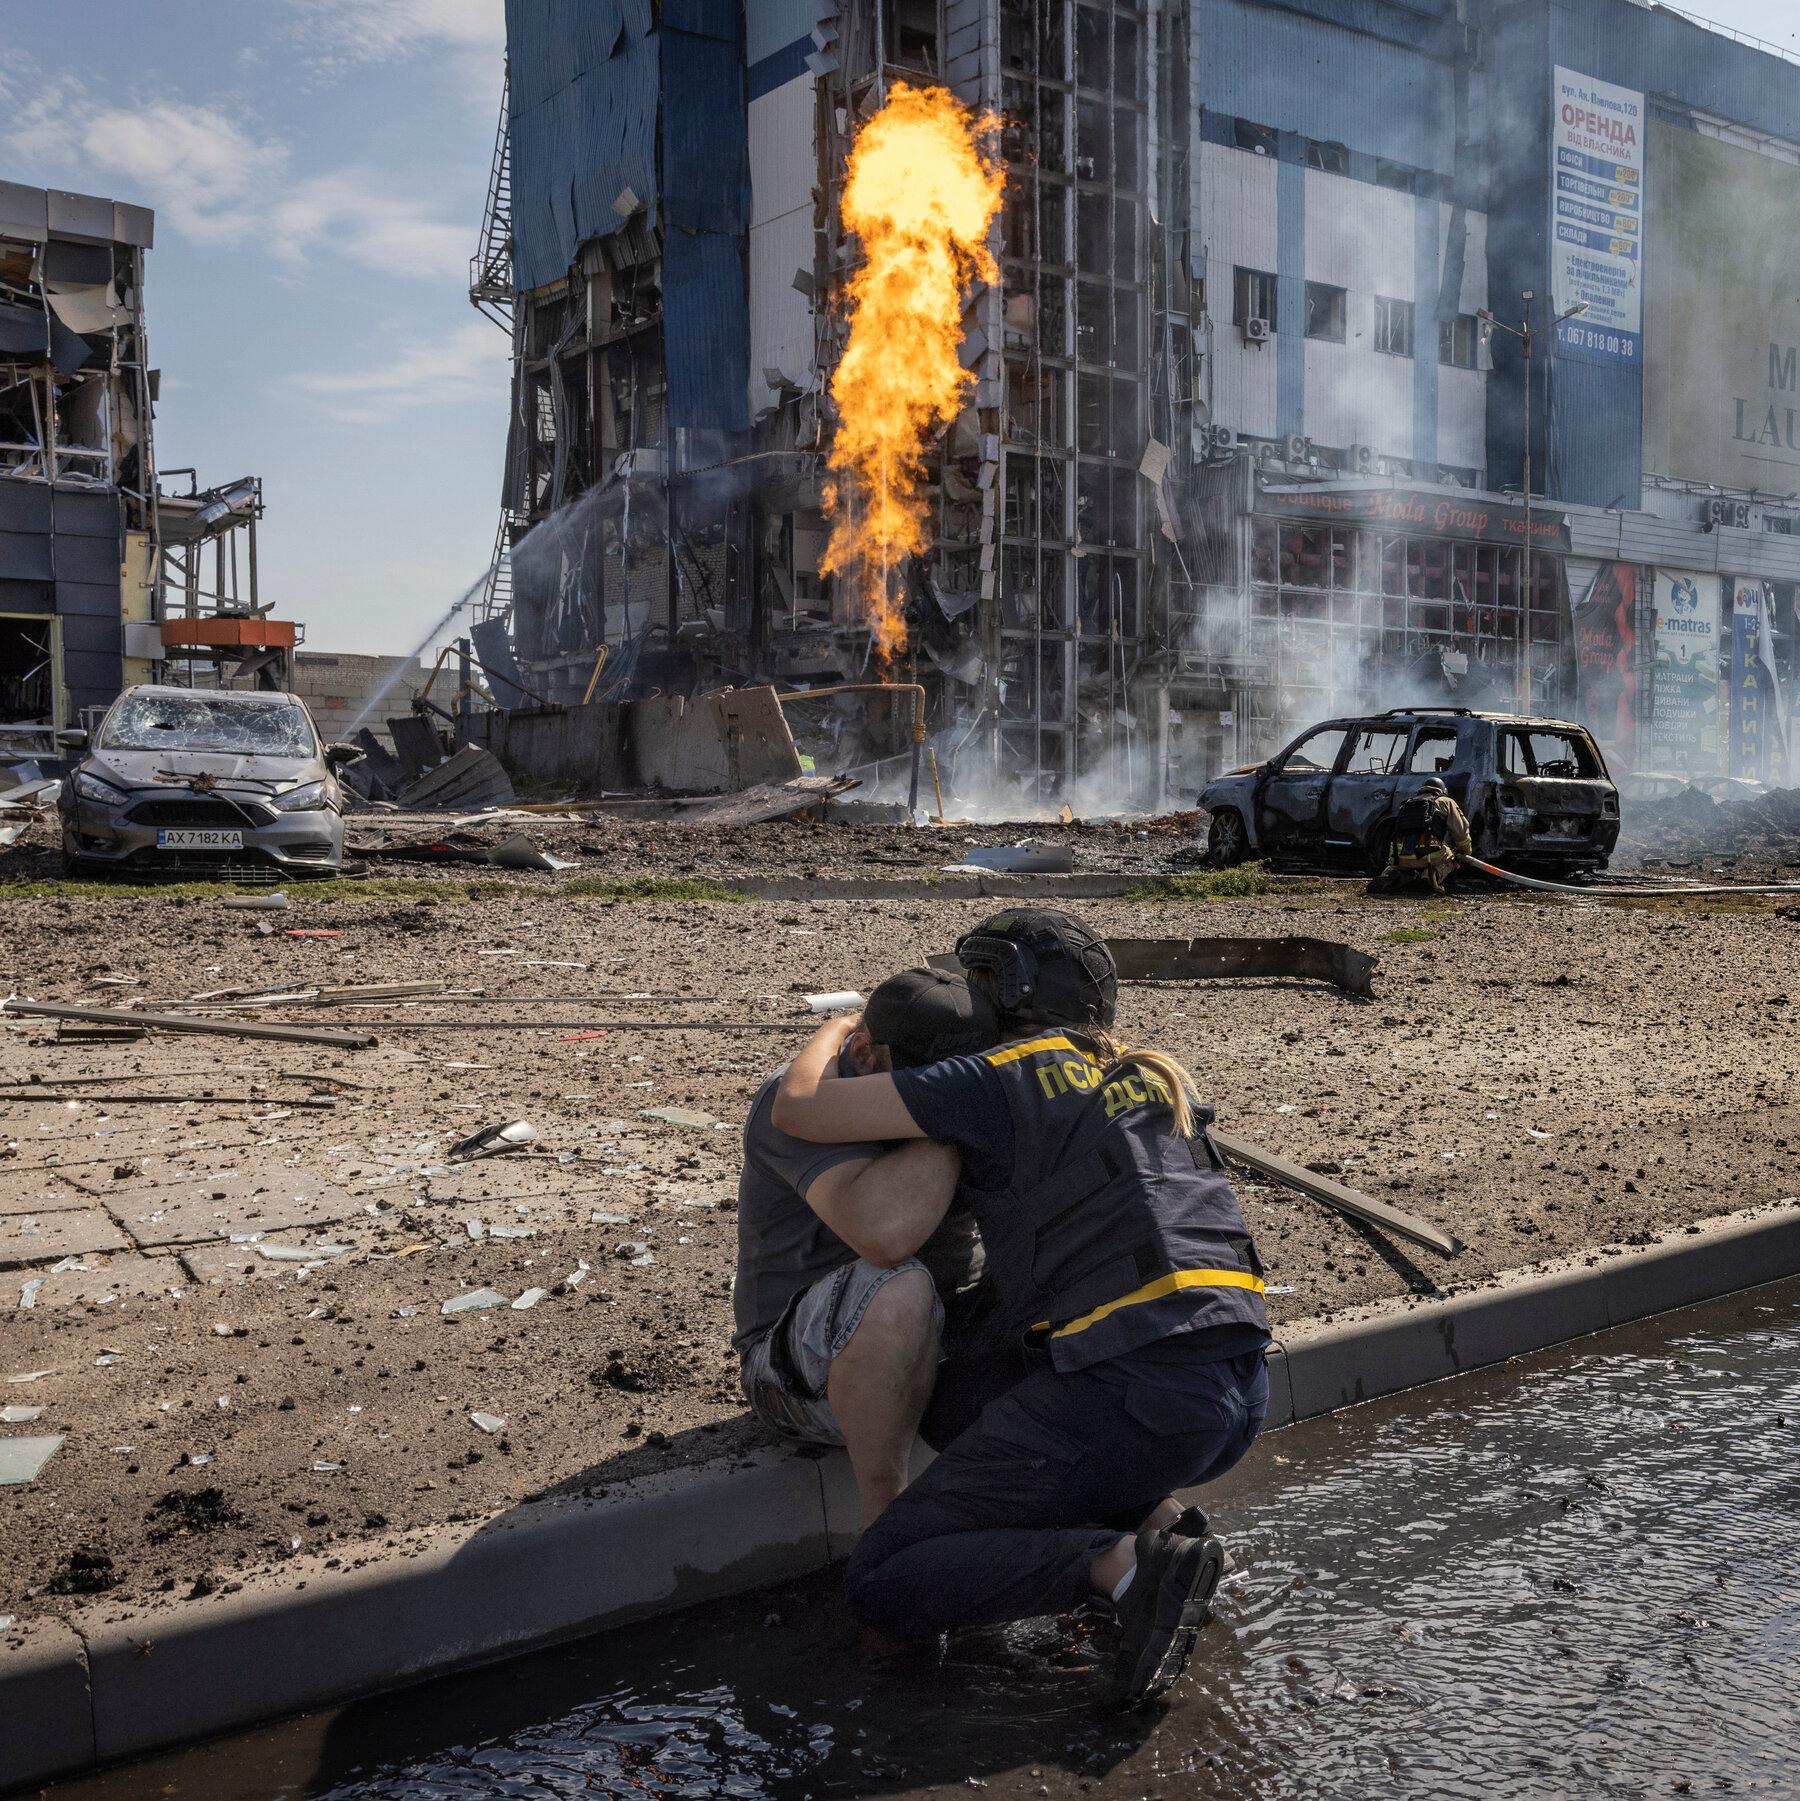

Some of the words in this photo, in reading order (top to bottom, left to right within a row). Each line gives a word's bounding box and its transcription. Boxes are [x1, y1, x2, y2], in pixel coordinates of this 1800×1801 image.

[1562, 103, 1637, 146] ОРЕНДА
[1567, 131, 1582, 147] ВІД
[1583, 136, 1632, 160] ВЛАСНИКА
[1559, 200, 1610, 225] ВИРОБНИЦТВО
[1559, 226, 1588, 243] СКЛАДИ
[1567, 326, 1585, 346] 067
[1587, 331, 1605, 351] 818
[1607, 336, 1619, 353] 00
[1621, 339, 1633, 356] 38
[1366, 491, 1424, 522] Moda
[1434, 501, 1489, 539] Group
[1503, 518, 1560, 537] ткаини
[1656, 617, 1711, 634] e-matras
[1654, 709, 1697, 720] ПОДУШКИ
[1742, 634, 1758, 779] ТКАНИНИ
[188, 832, 219, 844] 7182
